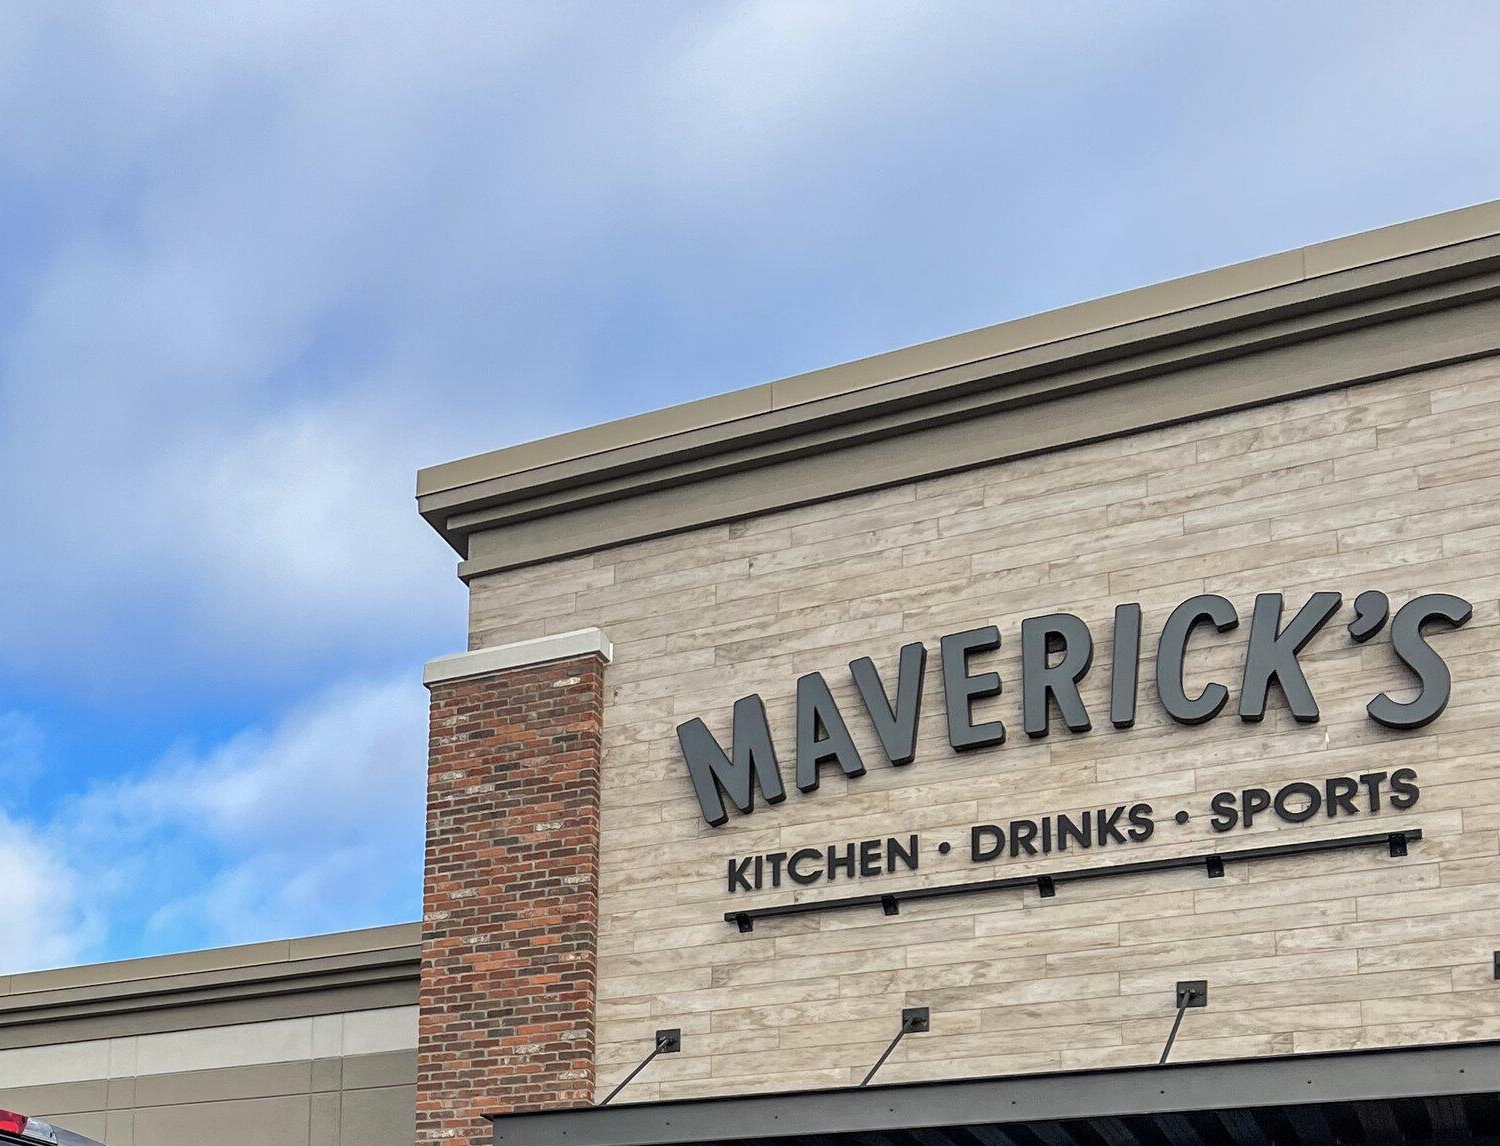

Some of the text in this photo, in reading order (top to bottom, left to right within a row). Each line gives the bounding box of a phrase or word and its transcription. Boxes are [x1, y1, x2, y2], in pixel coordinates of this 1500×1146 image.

[676, 590, 1473, 827] MAVERICK'S
[727, 767, 1421, 892] KITCHEN DRINKS SPORTS
